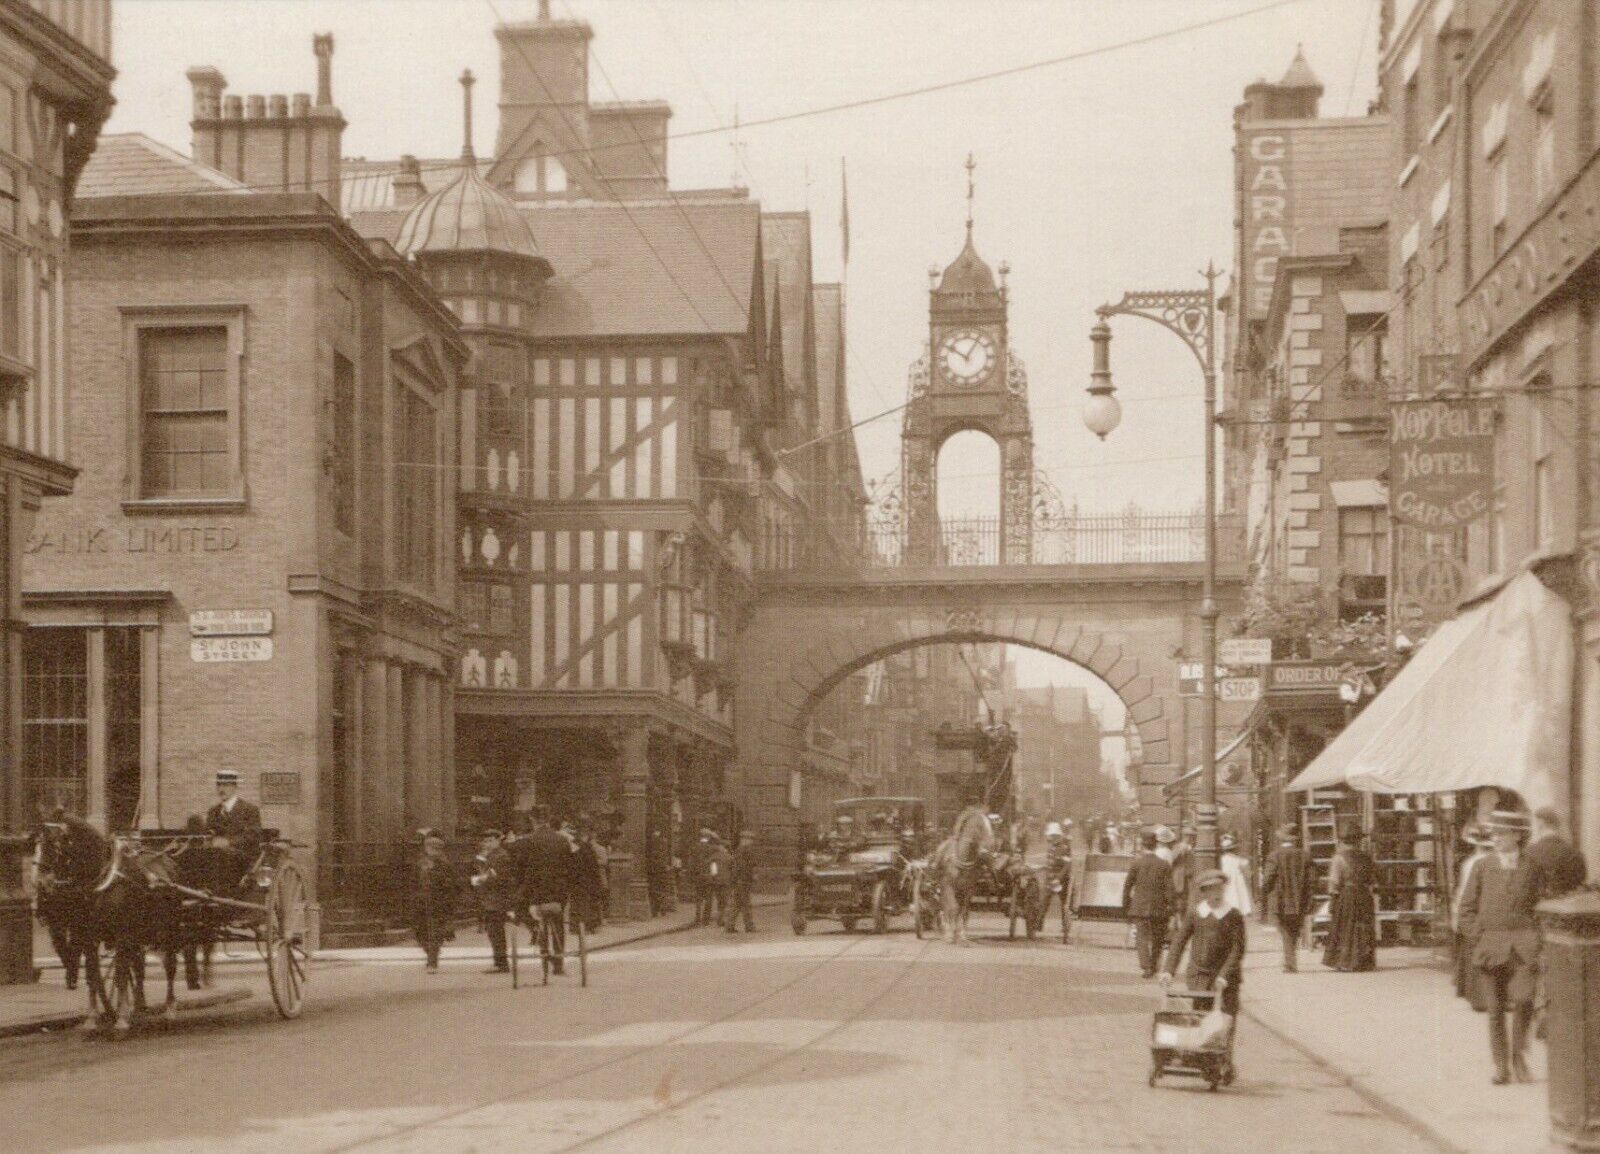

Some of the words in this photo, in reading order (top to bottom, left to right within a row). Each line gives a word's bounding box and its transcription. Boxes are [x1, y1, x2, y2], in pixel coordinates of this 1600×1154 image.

[1402, 445, 1481, 483] HOTEL
[127, 526, 240, 554] LIMITED
[219, 639, 262, 651] JOHN
[202, 650, 258, 661] STREET
[1275, 667, 1322, 683] ORDER
[1225, 680, 1256, 698] STOP
